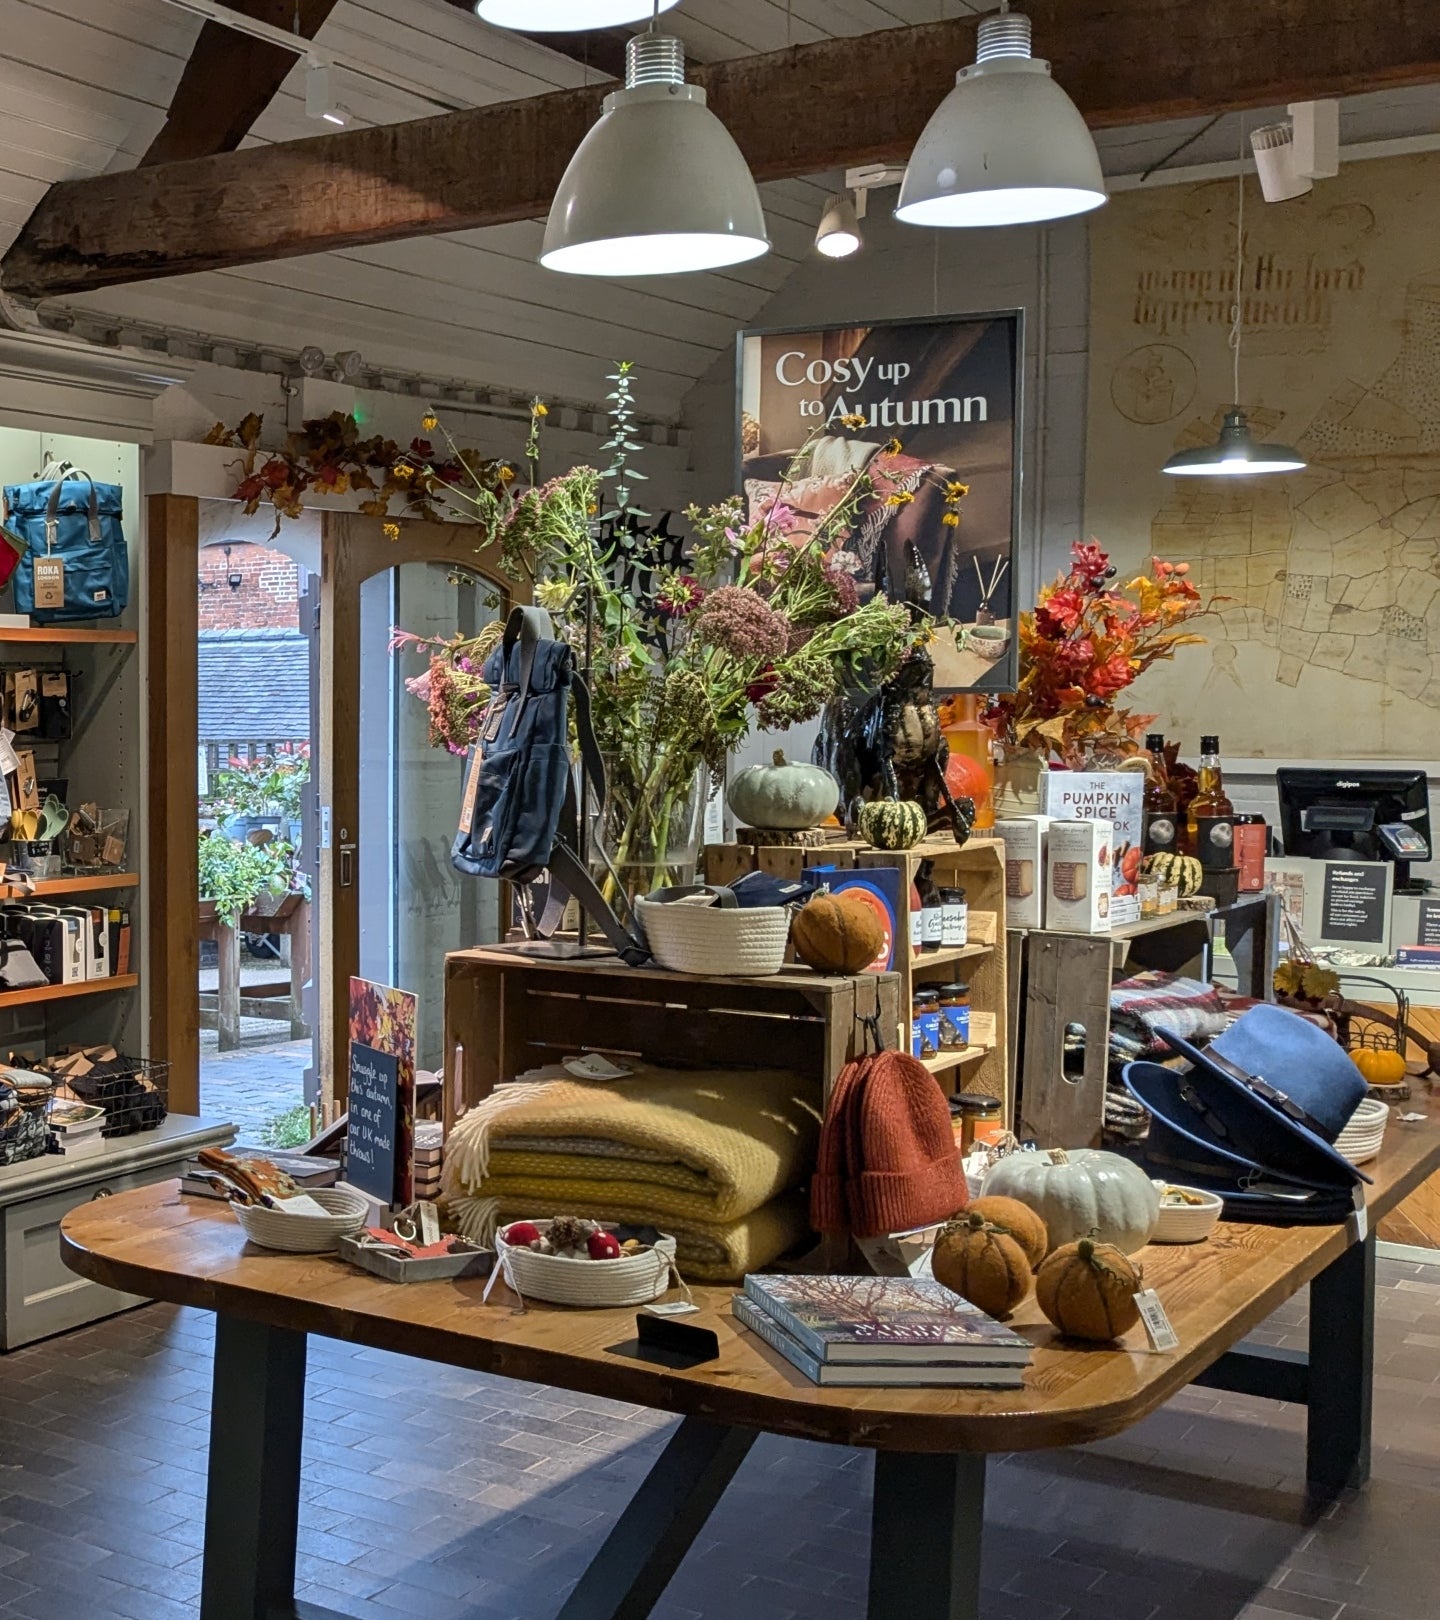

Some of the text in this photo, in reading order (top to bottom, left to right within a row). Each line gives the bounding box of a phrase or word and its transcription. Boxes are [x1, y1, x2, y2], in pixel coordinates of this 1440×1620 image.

[775, 351, 910, 393] Cosy up
[799, 395, 988, 429] to Autumn
[37, 565, 59, 575] ROKA
[1089, 781, 1106, 790] THE
[1335, 780, 1361, 789] digipos
[1063, 792, 1131, 806] PUMPKIN
[1075, 806, 1117, 819] SPICE
[351, 1054, 388, 1090] Snuggle up
[350, 1078, 393, 1110] this autumn,
[350, 1100, 382, 1128] in one of
[350, 1123, 391, 1151] our UK made
[349, 1141, 375, 1170] throws!
[853, 1323, 968, 1332] WINTER
[854, 1330, 983, 1338] GARDENS
